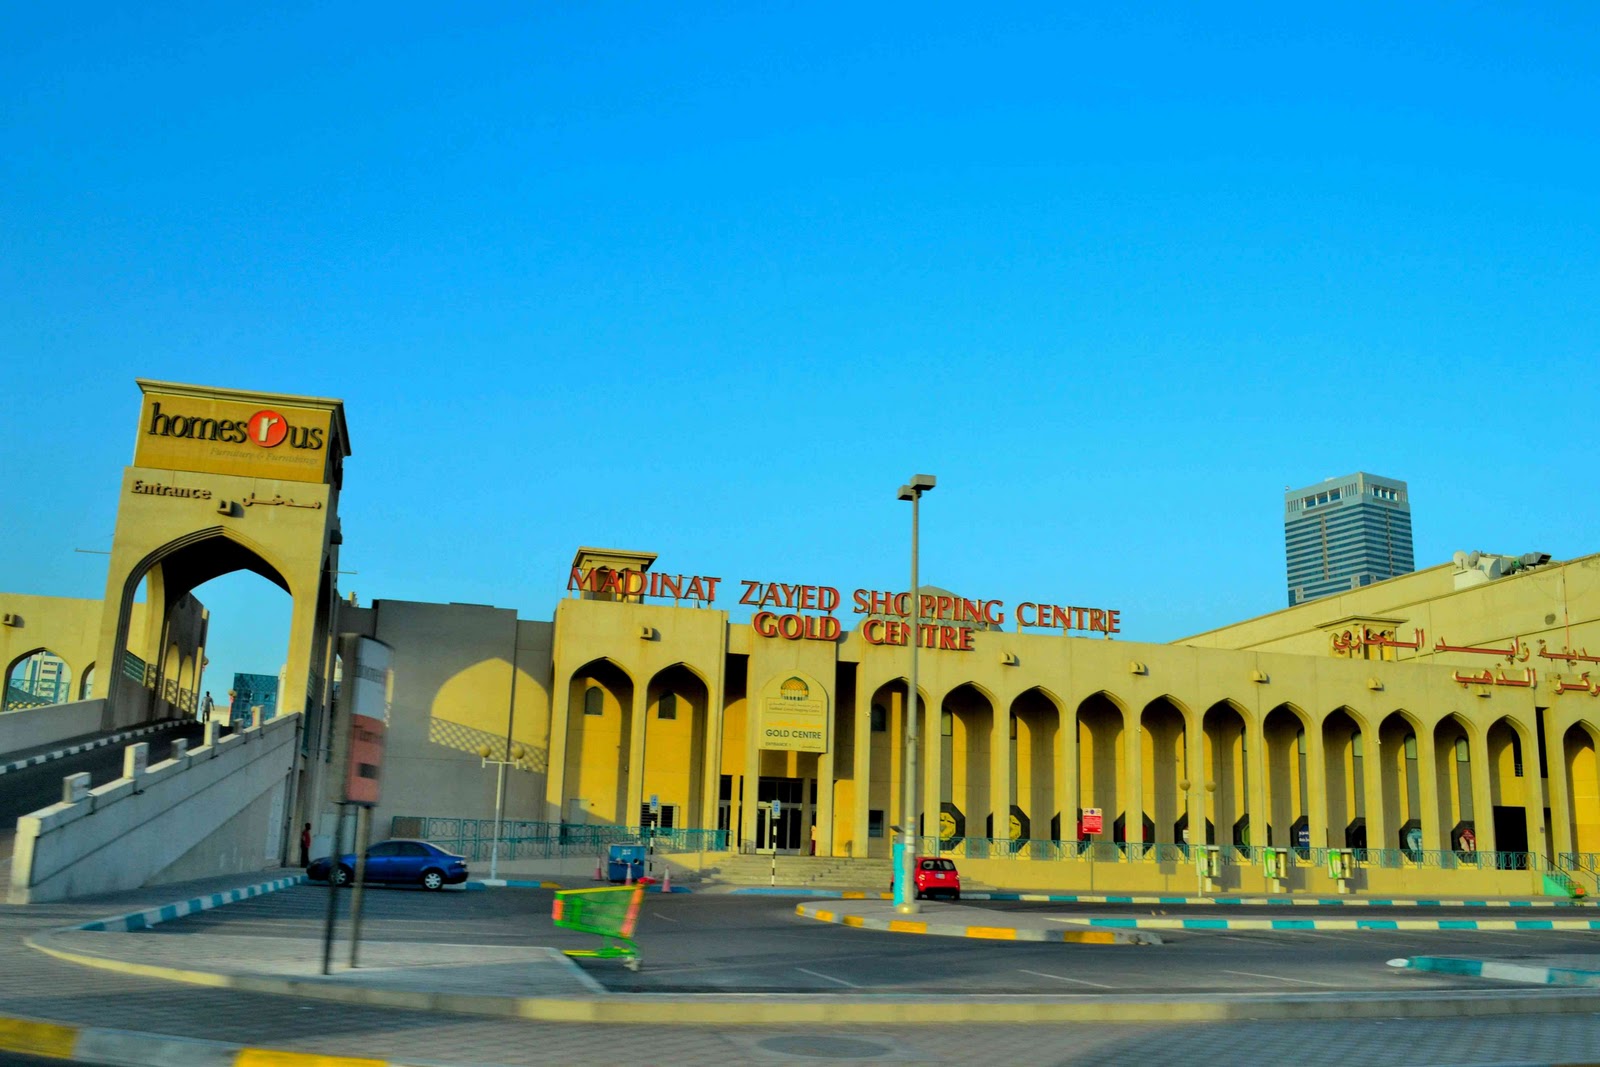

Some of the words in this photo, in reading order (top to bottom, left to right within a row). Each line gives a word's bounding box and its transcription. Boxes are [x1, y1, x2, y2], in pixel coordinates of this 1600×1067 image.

[148, 401, 248, 443] homes
[288, 424, 324, 450] us
[131, 480, 212, 500] Entrance
[242, 493, 322, 510] مدخل
[567, 566, 722, 602] MADINAT
[739, 580, 841, 612] ZAYED
[853, 589, 1004, 626] SHOPPING
[1016, 602, 1120, 633] CENTRE
[753, 611, 841, 641] GOLD
[863, 619, 976, 651] CENTRE
[1536, 638, 1600, 667] دينة
[1554, 671, 1600, 697] ركز
[766, 729, 790, 738] GOLD
[791, 730, 822, 740] CENTRE
